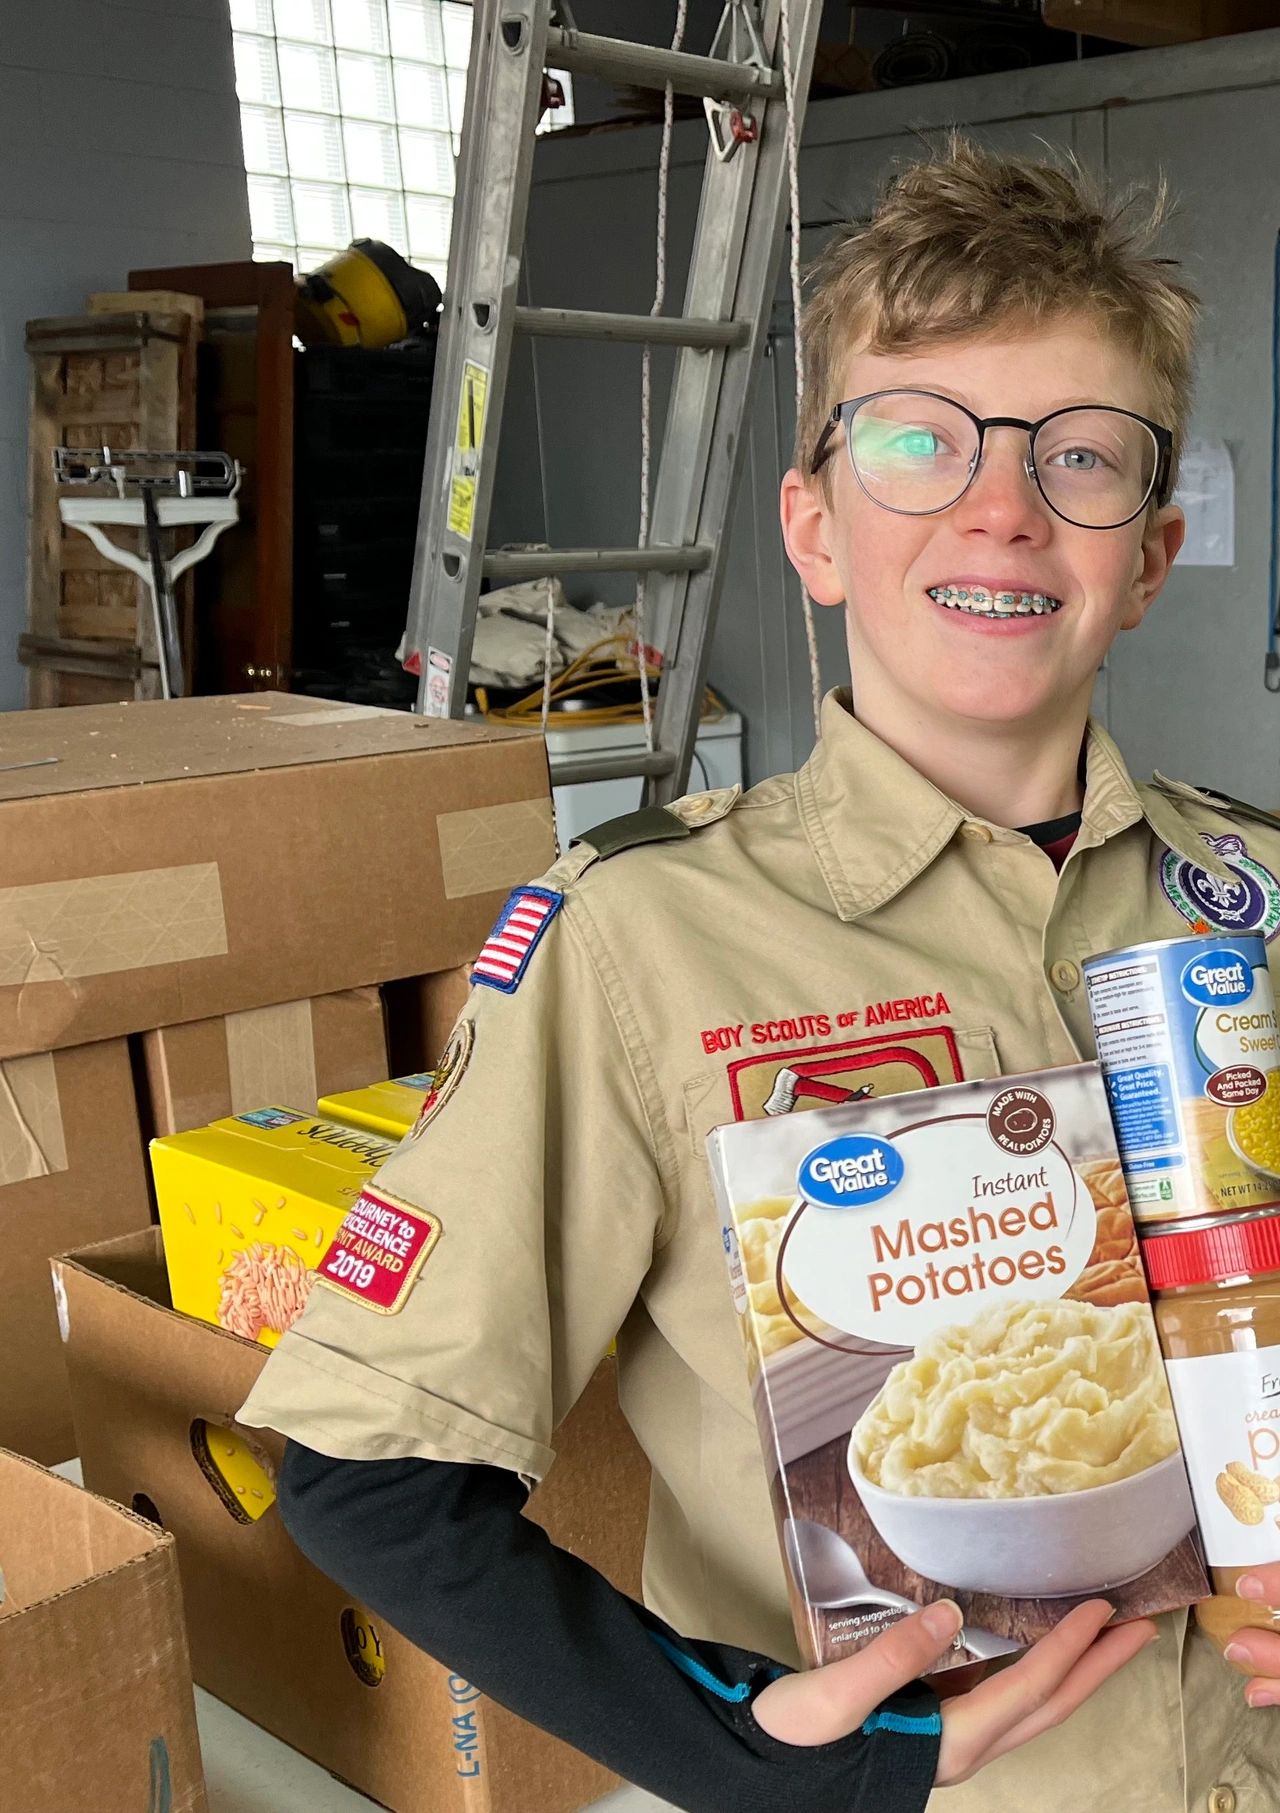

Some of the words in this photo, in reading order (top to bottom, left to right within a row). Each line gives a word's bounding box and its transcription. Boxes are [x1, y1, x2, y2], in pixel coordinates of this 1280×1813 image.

[1190, 962, 1245, 986] Great
[1206, 981, 1246, 996] Value
[700, 1024, 744, 1054] BOY
[751, 1014, 831, 1044] SCOUTS
[836, 1011, 860, 1028] OF
[864, 992, 952, 1027] AMERICA
[1215, 1012, 1273, 1033] Cream
[1239, 1035, 1277, 1053] Sweet
[1117, 1073, 1134, 1083] Great
[1217, 1082, 1234, 1091] And
[1234, 1077, 1262, 1089] Packed
[1225, 1070, 1252, 1081] Picked
[1118, 1082, 1136, 1092] Great
[1221, 1089, 1244, 1099] Same
[1245, 1087, 1259, 1096] Day
[991, 1092, 1015, 1117] MADE
[1014, 1091, 1038, 1104] WITH
[997, 1133, 1019, 1152] REAL
[1020, 1118, 1052, 1152] POTATOES
[809, 1148, 886, 1182] Great
[830, 1172, 889, 1194] Value
[972, 1166, 1050, 1199] Instant
[1220, 1185, 1237, 1198] NET
[1239, 1183, 1251, 1195] WT
[397, 1220, 416, 1239] to
[869, 1191, 1058, 1263] Mashed
[351, 1238, 404, 1273] AWARD
[326, 1249, 376, 1289] 2019
[866, 1244, 1067, 1312] Potatoes
[828, 1615, 861, 1632] serving
[831, 1627, 869, 1644] enlarged
[871, 1624, 881, 1635] to
